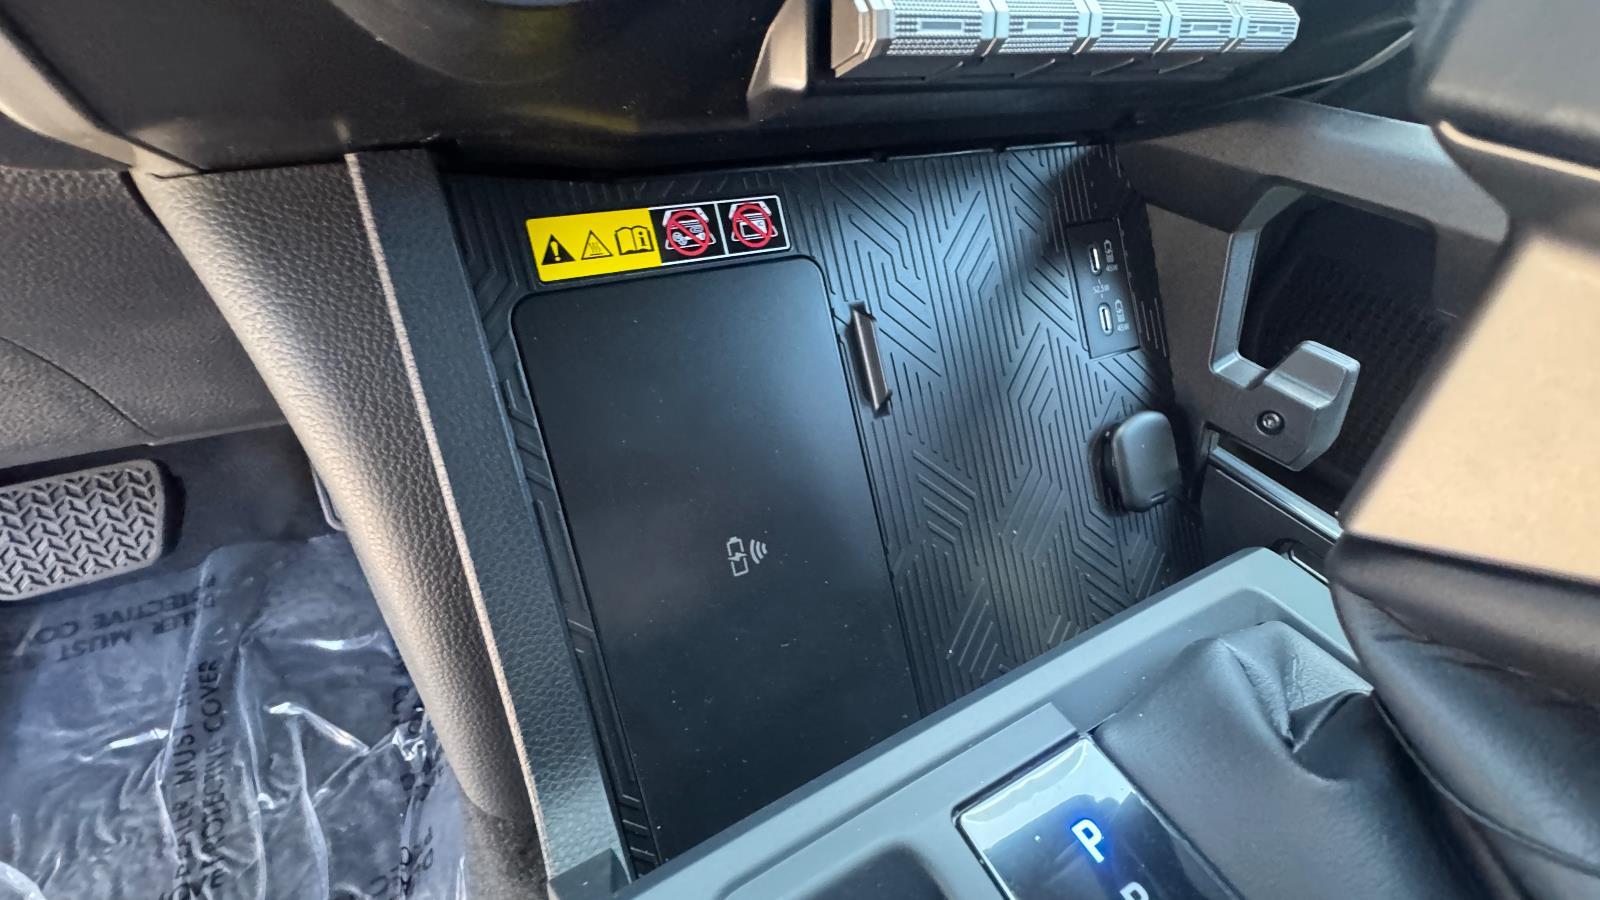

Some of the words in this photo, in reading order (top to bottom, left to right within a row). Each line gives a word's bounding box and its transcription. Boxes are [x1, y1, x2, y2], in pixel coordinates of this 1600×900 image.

[56, 629, 133, 662] MUST
[198, 660, 224, 733] COVER
[173, 724, 196, 786] MUST
[1070, 818, 1105, 863] P
